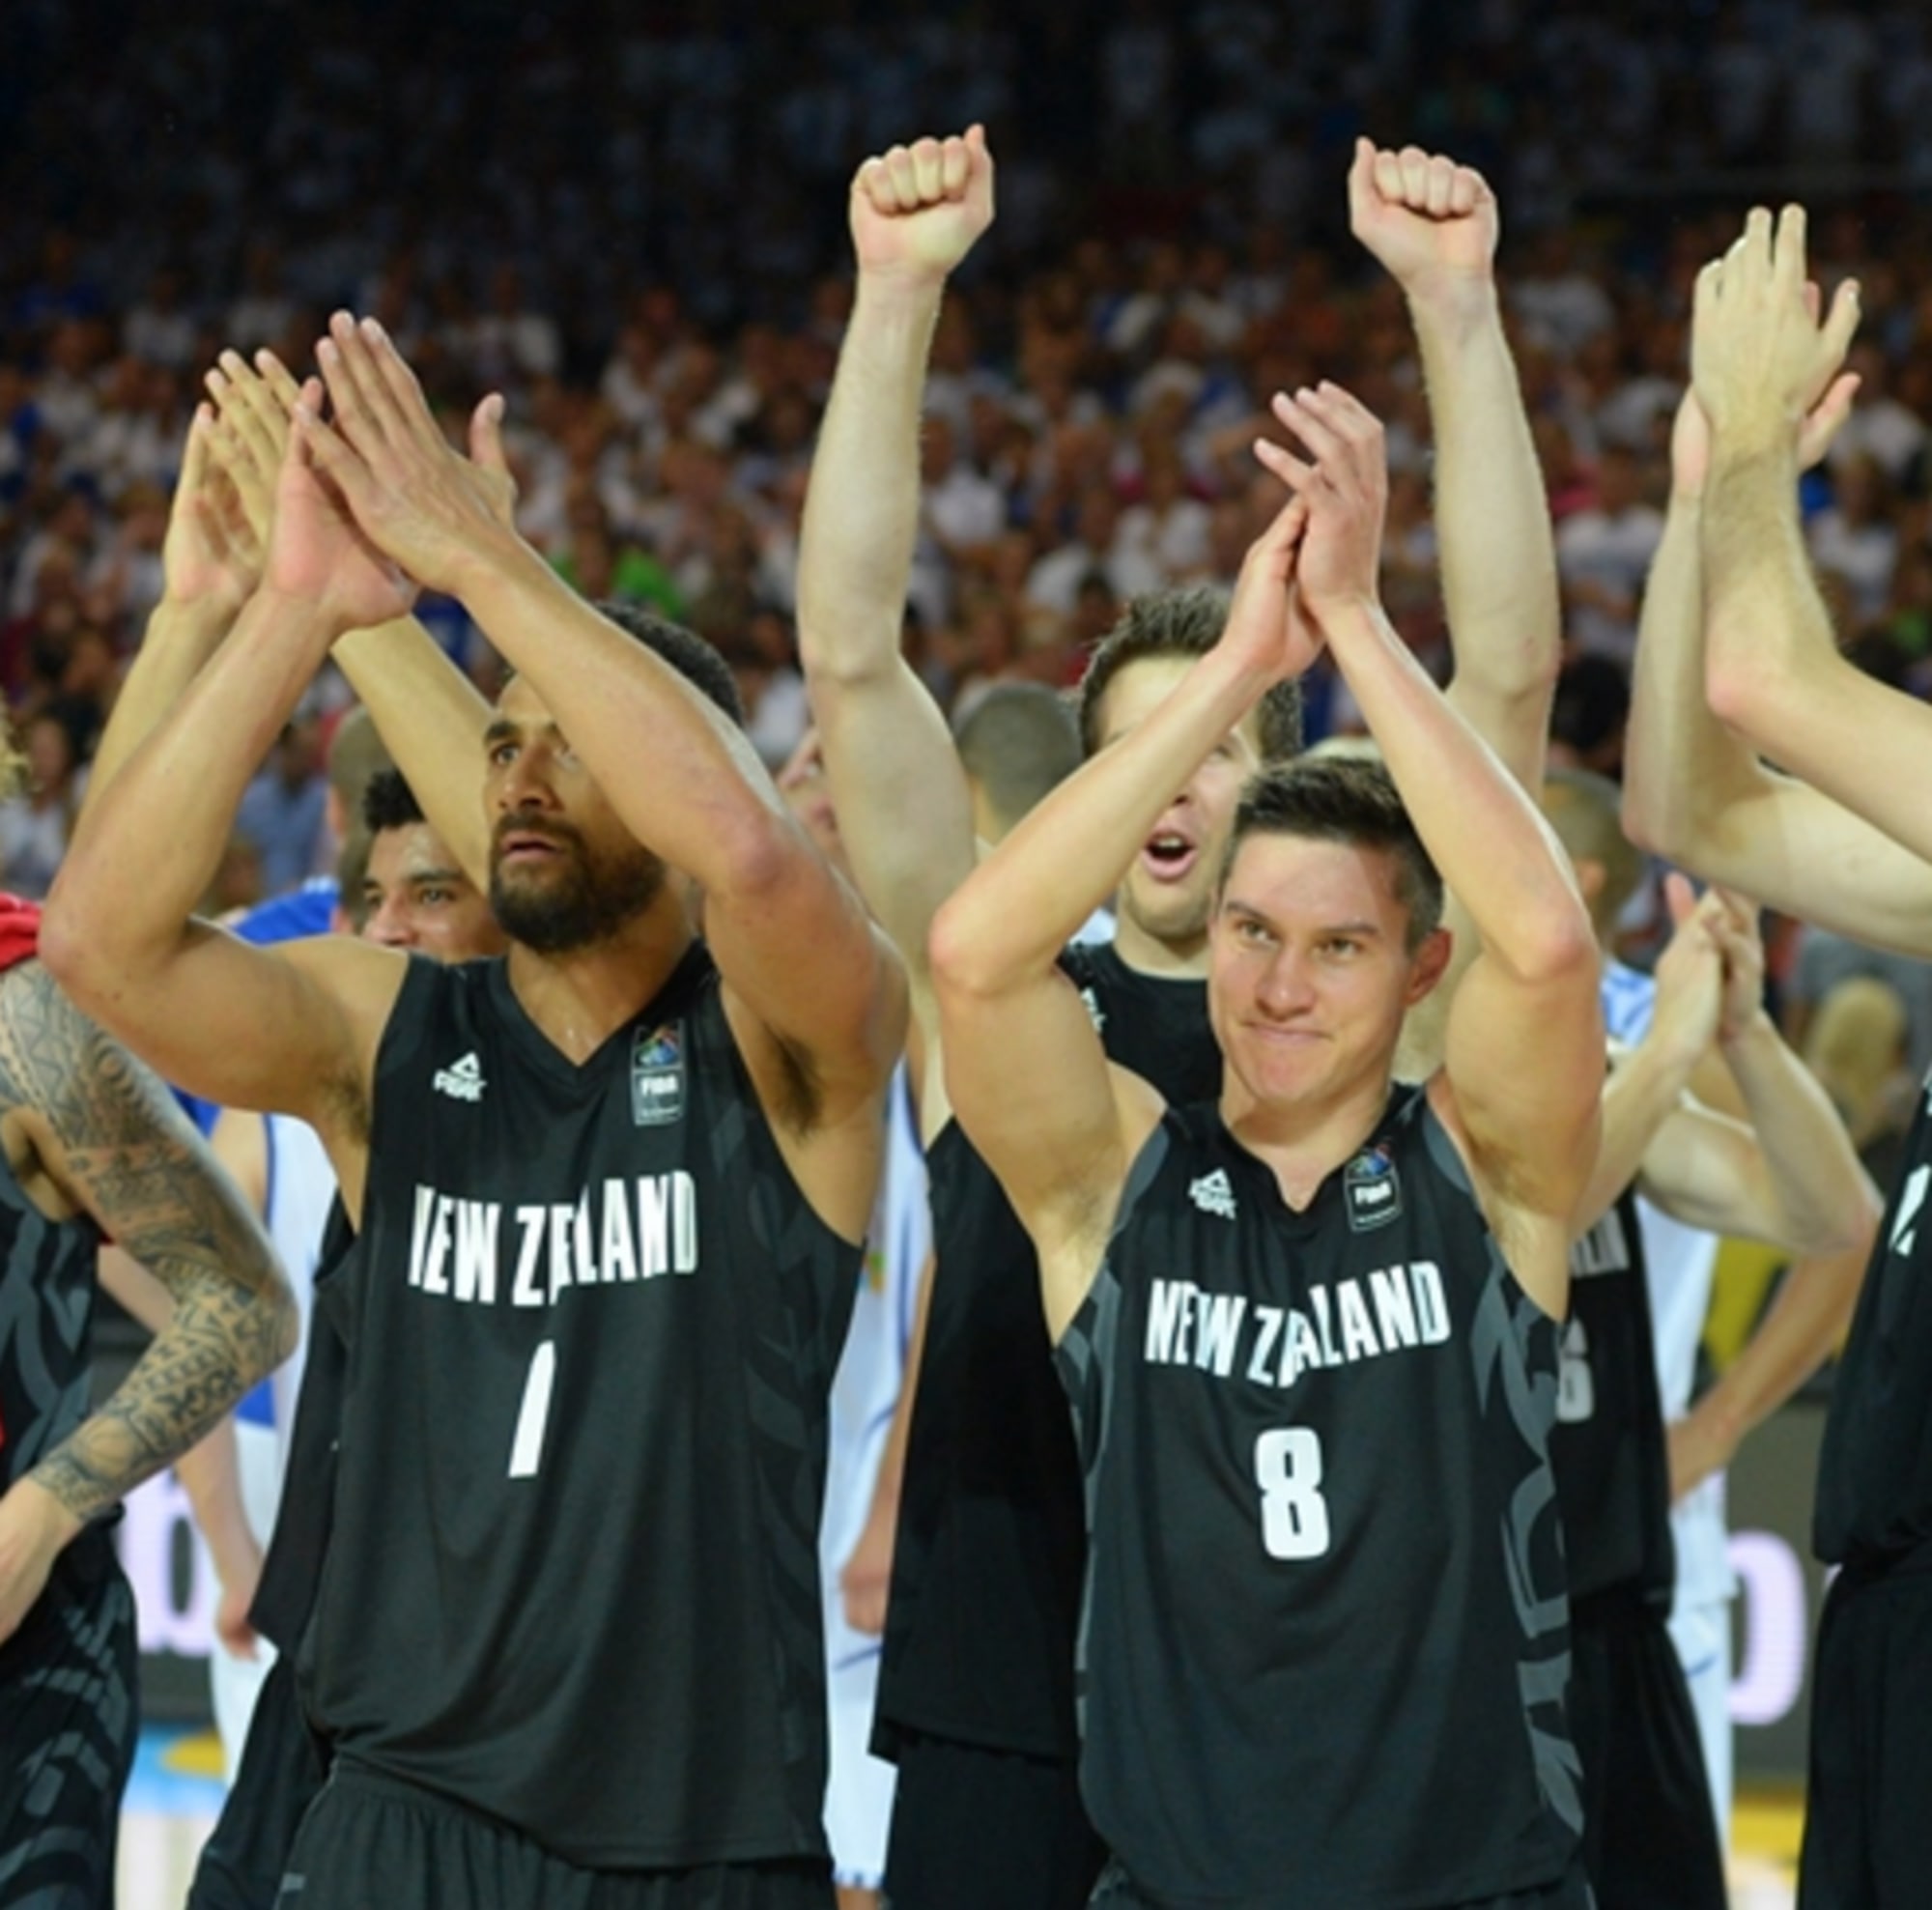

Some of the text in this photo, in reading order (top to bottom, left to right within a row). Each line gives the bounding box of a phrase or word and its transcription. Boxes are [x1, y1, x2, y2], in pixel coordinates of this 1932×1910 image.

[1144, 1278, 1248, 1379] NEW
[507, 1339, 556, 1479] 1
[1255, 1427, 1330, 1560] 8
